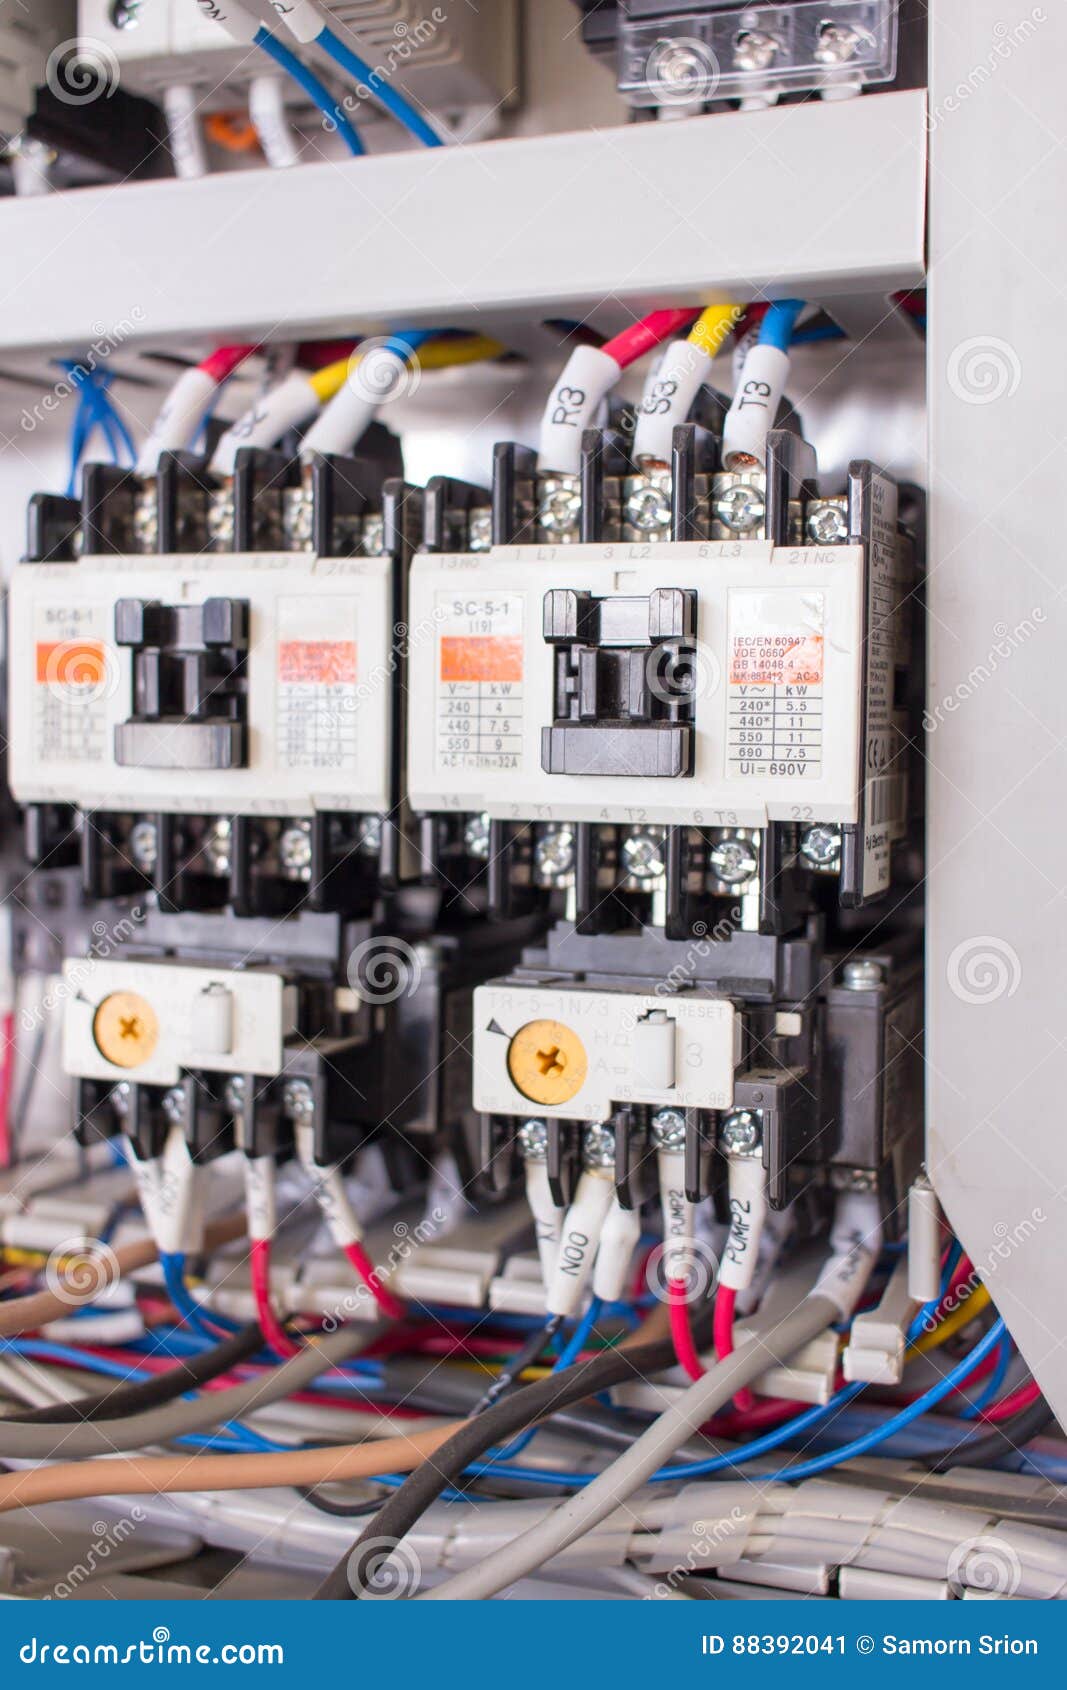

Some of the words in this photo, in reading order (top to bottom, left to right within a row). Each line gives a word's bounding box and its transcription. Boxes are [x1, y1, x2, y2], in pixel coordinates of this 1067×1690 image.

[739, 380, 771, 411] T3
[552, 386, 585, 427] R3
[453, 601, 509, 616] SC-5-1
[786, 701, 807, 712] 5.5
[789, 717, 804, 727] 11
[739, 732, 763, 742] 550
[789, 732, 804, 743] 11
[786, 748, 806, 758] 7.5
[714, 810, 739, 825] T3
[728, 1198, 751, 1266] PUMP2
